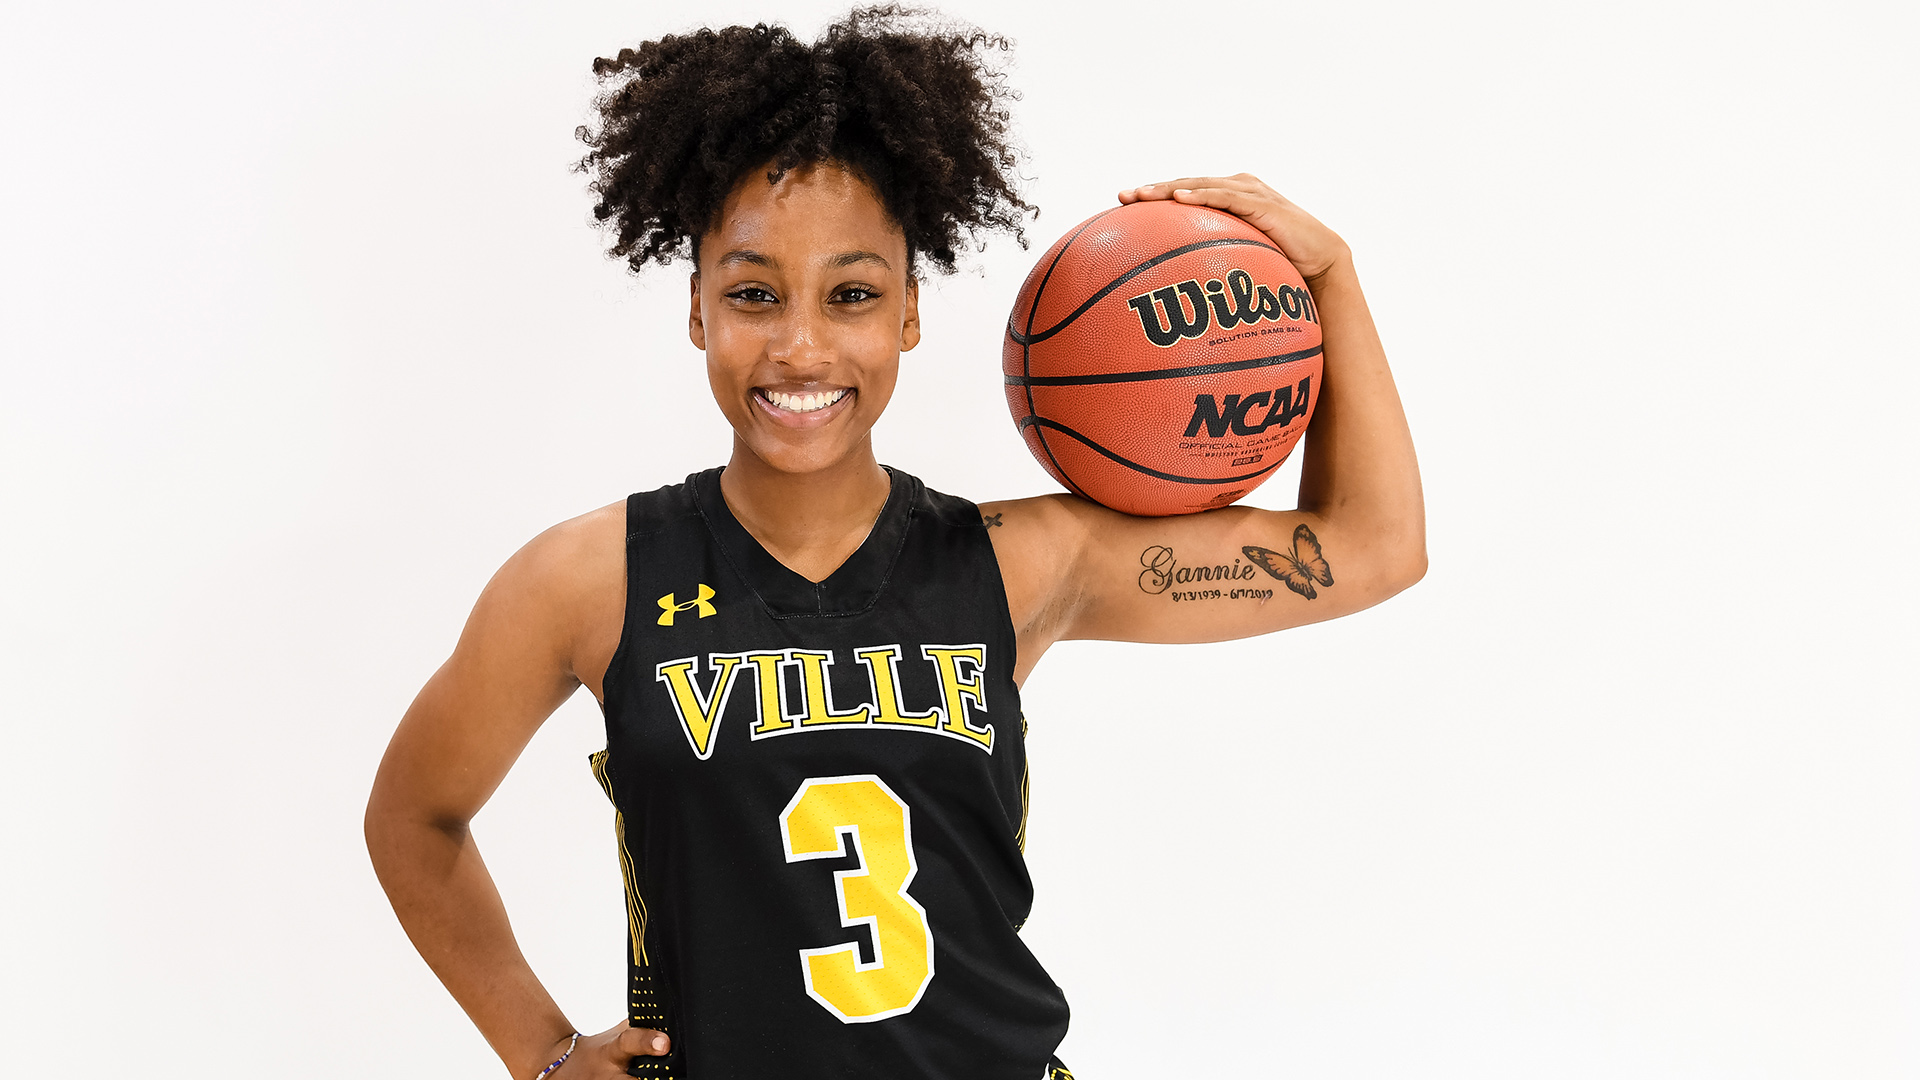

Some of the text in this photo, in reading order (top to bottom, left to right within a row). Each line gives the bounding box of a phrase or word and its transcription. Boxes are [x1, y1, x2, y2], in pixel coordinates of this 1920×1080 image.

[1126, 268, 1318, 348] Wilson
[1208, 330, 1258, 346] SOLUTION
[1260, 326, 1284, 336] GAME
[1183, 375, 1311, 438] NCAA
[1178, 442, 1243, 450] OFFICIAL
[1246, 433, 1281, 446] GAME
[1171, 589, 1221, 603] 8/13/1939
[1230, 588, 1273, 600] 6/7/2019
[656, 643, 995, 760] VILLE
[779, 774, 935, 1024] 3
